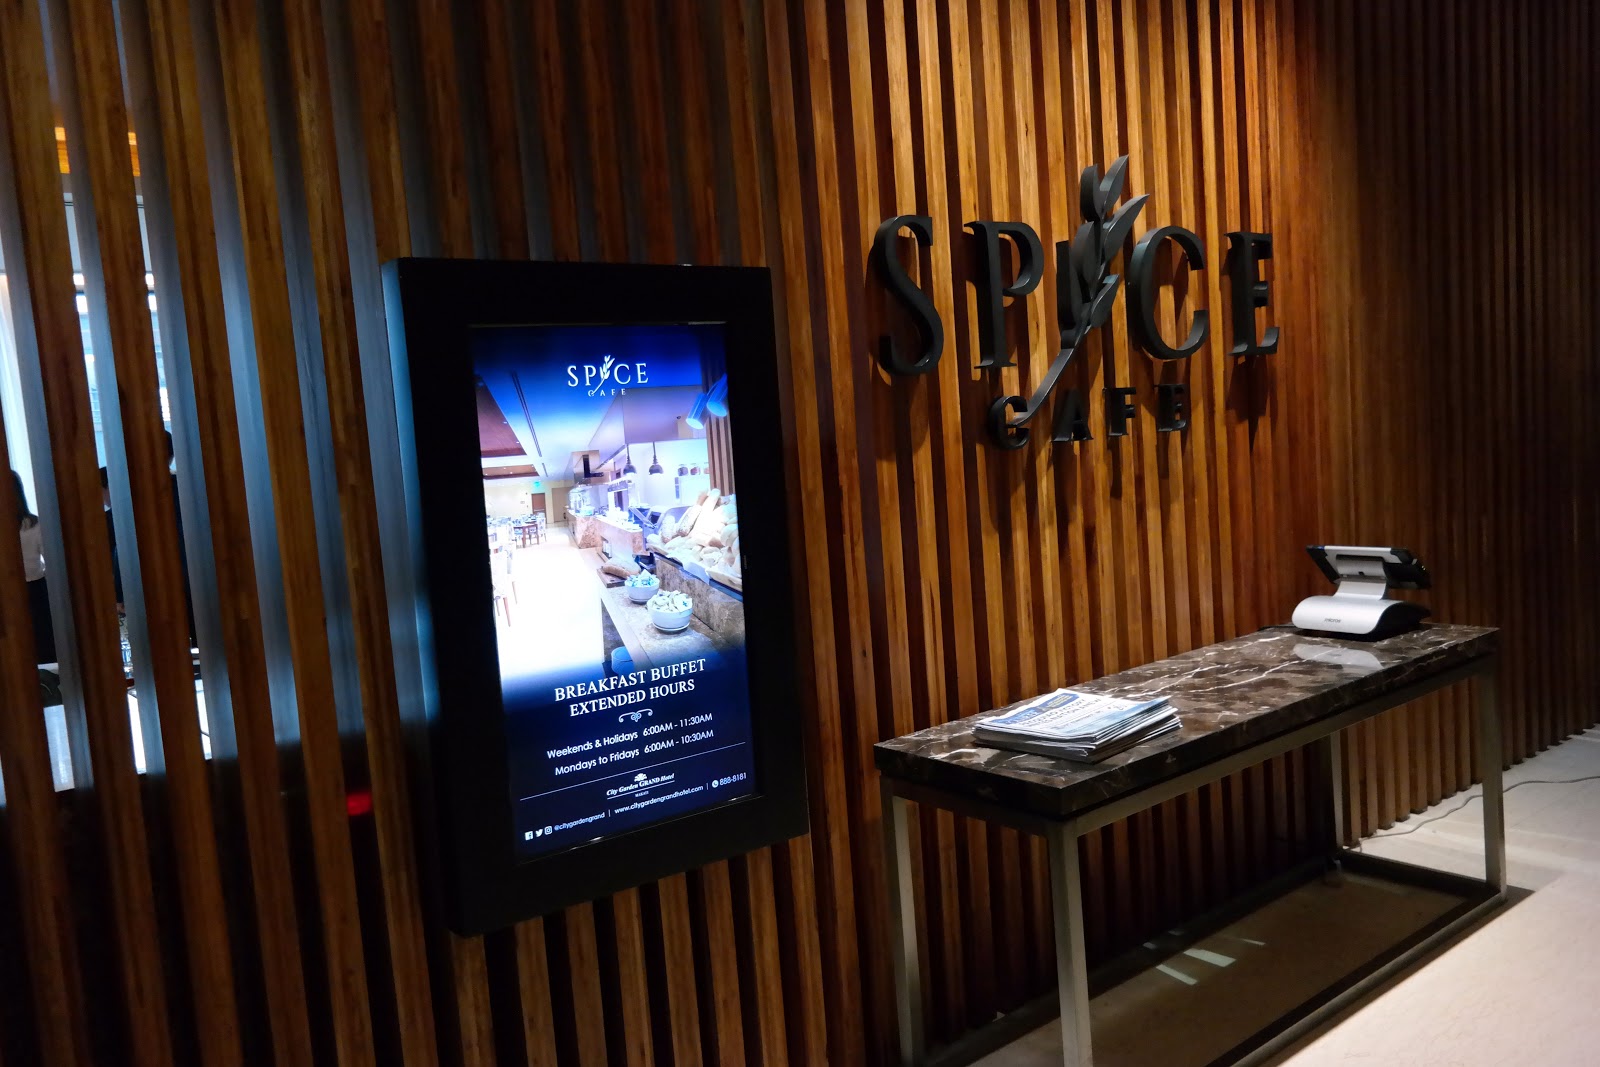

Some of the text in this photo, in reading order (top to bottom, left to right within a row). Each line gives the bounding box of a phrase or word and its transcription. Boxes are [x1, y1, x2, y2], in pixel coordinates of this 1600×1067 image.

[867, 213, 1280, 376] SPICE
[567, 360, 649, 388] SPICE
[587, 388, 627, 398] CAFE
[989, 383, 1188, 451] CAFE
[554, 658, 706, 702] BREAKFAST BUFFET
[569, 678, 695, 717] EXTENDED HOURS
[547, 740, 593, 759] Weekends
[595, 737, 602, 747] &
[603, 731, 639, 747] Holidays
[643, 722, 673, 737] 6:00AM
[680, 712, 713, 729] 11:30AM
[555, 760, 597, 776] Mondays
[599, 755, 608, 765] to
[609, 747, 640, 762] Fridays
[644, 740, 675, 755] 6:00AM
[681, 729, 714, 746] 10:30AM
[554, 811, 606, 831] @citygardengrand
[614, 785, 704, 814] www.citygardengrandhotel.com
[619, 784, 639, 793] Garden
